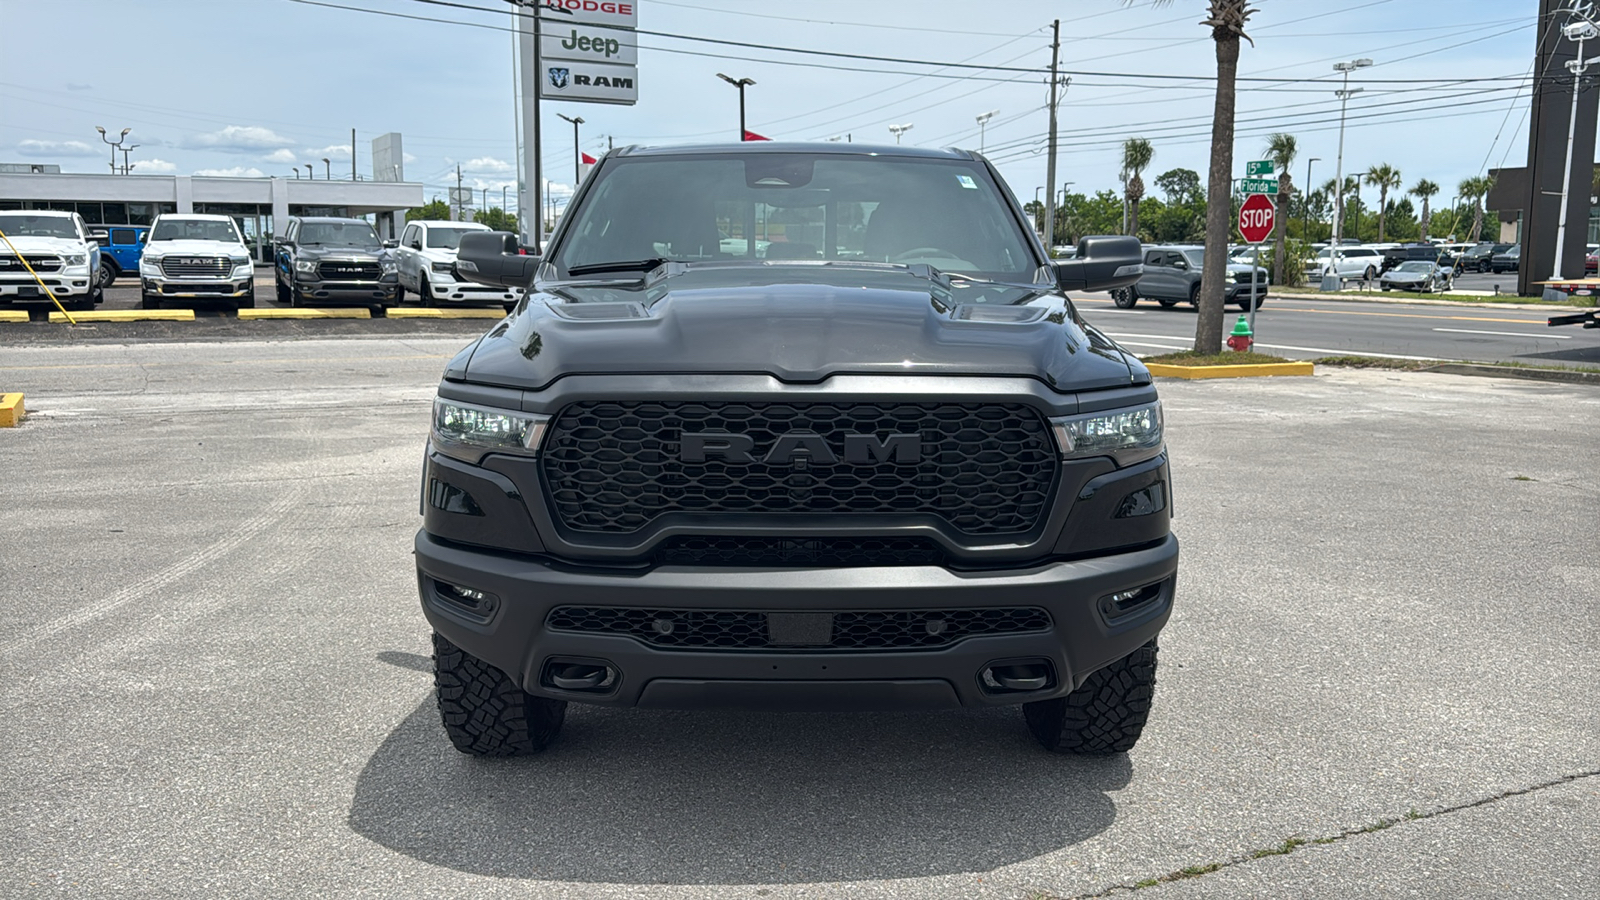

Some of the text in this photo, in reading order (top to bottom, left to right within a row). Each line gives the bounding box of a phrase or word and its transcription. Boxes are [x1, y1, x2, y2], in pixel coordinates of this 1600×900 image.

[561, 29, 619, 58] Jeep
[574, 74, 633, 89] RAM
[1242, 180, 1268, 192] Florida
[1241, 208, 1273, 229] STOP
[680, 432, 921, 463] RAM
